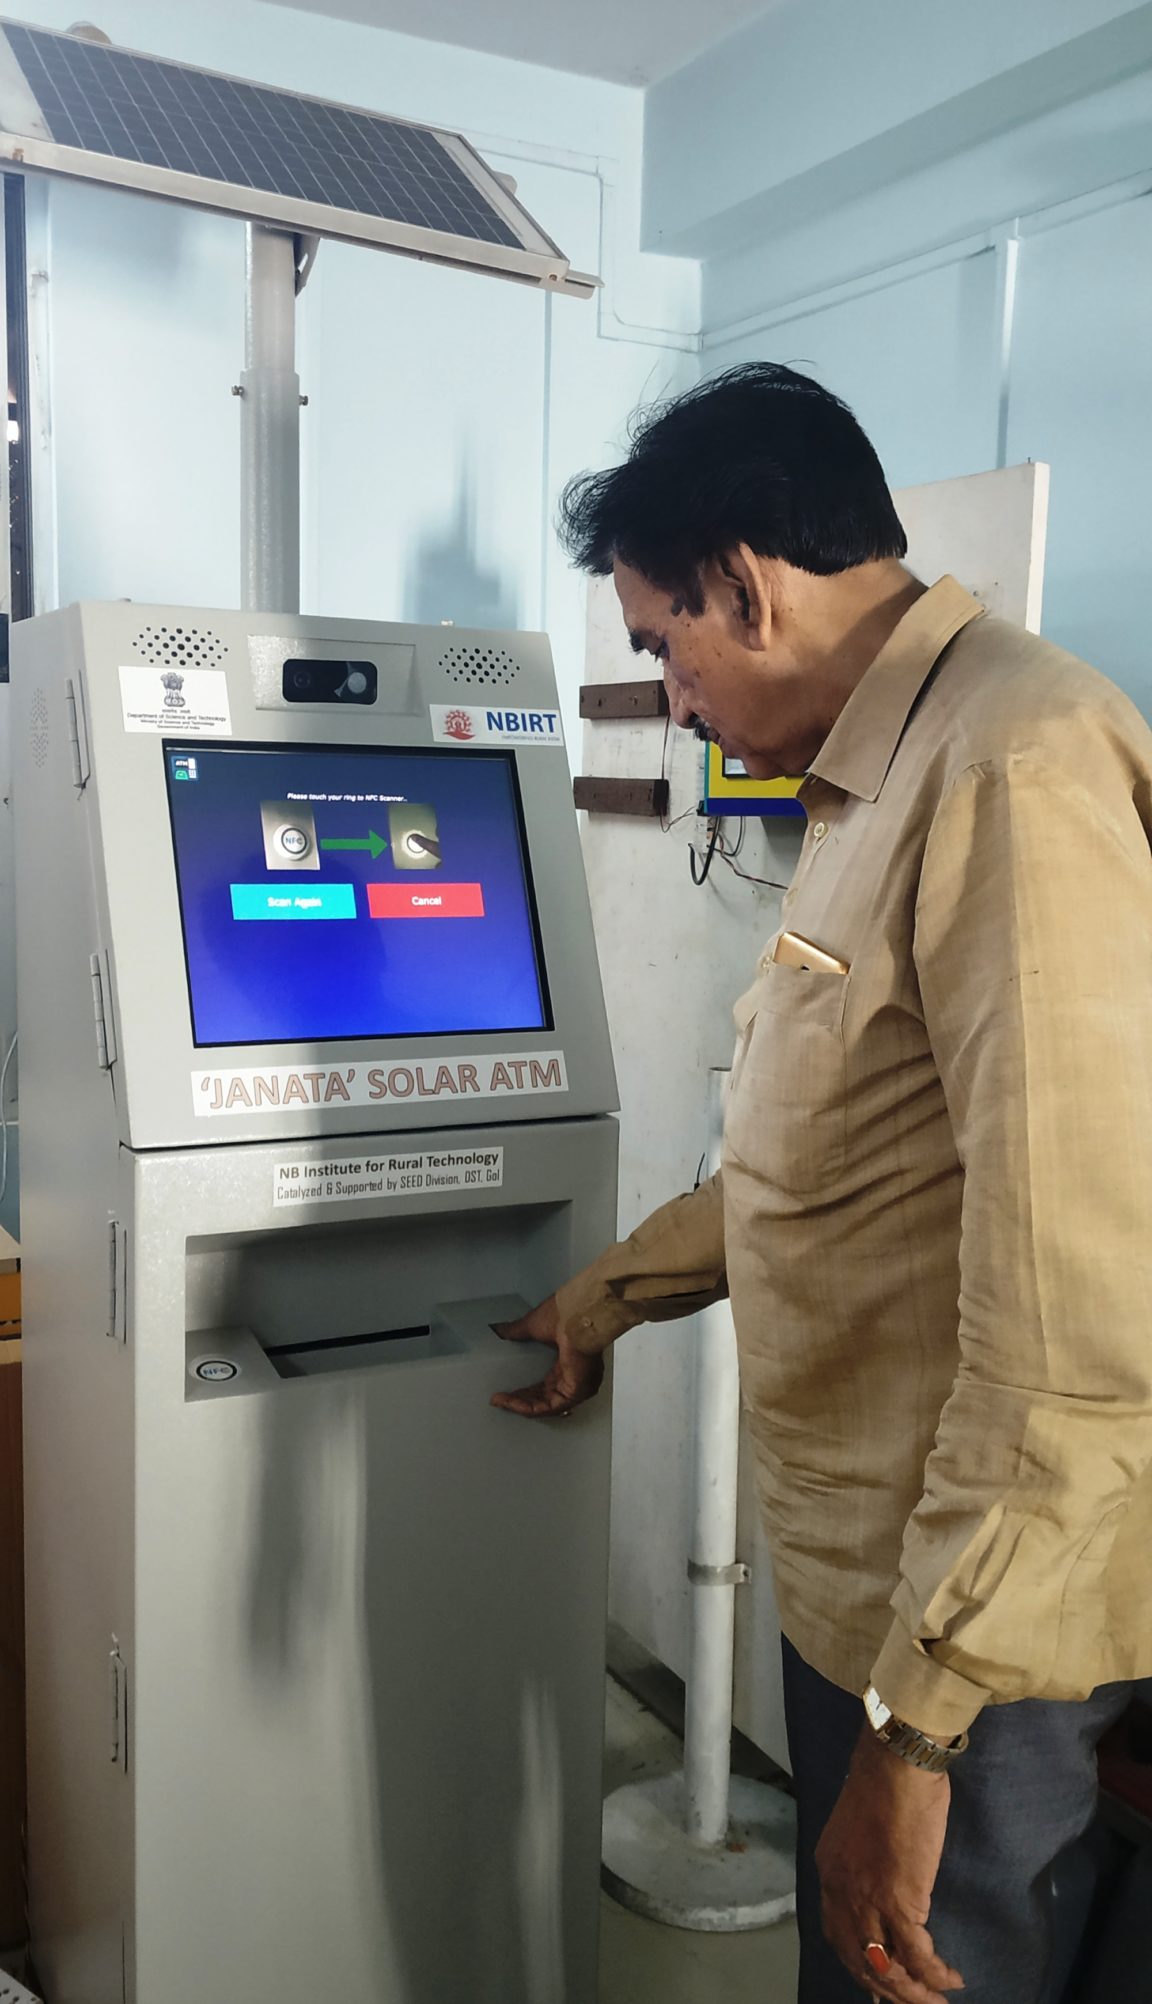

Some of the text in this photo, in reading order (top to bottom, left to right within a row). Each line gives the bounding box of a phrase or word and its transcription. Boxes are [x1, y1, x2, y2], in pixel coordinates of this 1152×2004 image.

[486, 711, 557, 733] NBIRT
[286, 792, 308, 800] Please
[327, 794, 343, 802] your
[343, 794, 356, 802] ring
[285, 837, 303, 845] NFC
[267, 896, 322, 910] Scan Again
[411, 896, 442, 907] Cancel
[368, 1064, 480, 1099] SOLAR
[490, 1058, 562, 1092] ATM
[280, 1152, 499, 1179] NB Institute for Rural Technology
[277, 1183, 322, 1200] Catalyzed
[326, 1182, 333, 1195] &
[335, 1177, 383, 1196] Supported
[387, 1177, 397, 1192] by
[400, 1174, 423, 1189] SEED
